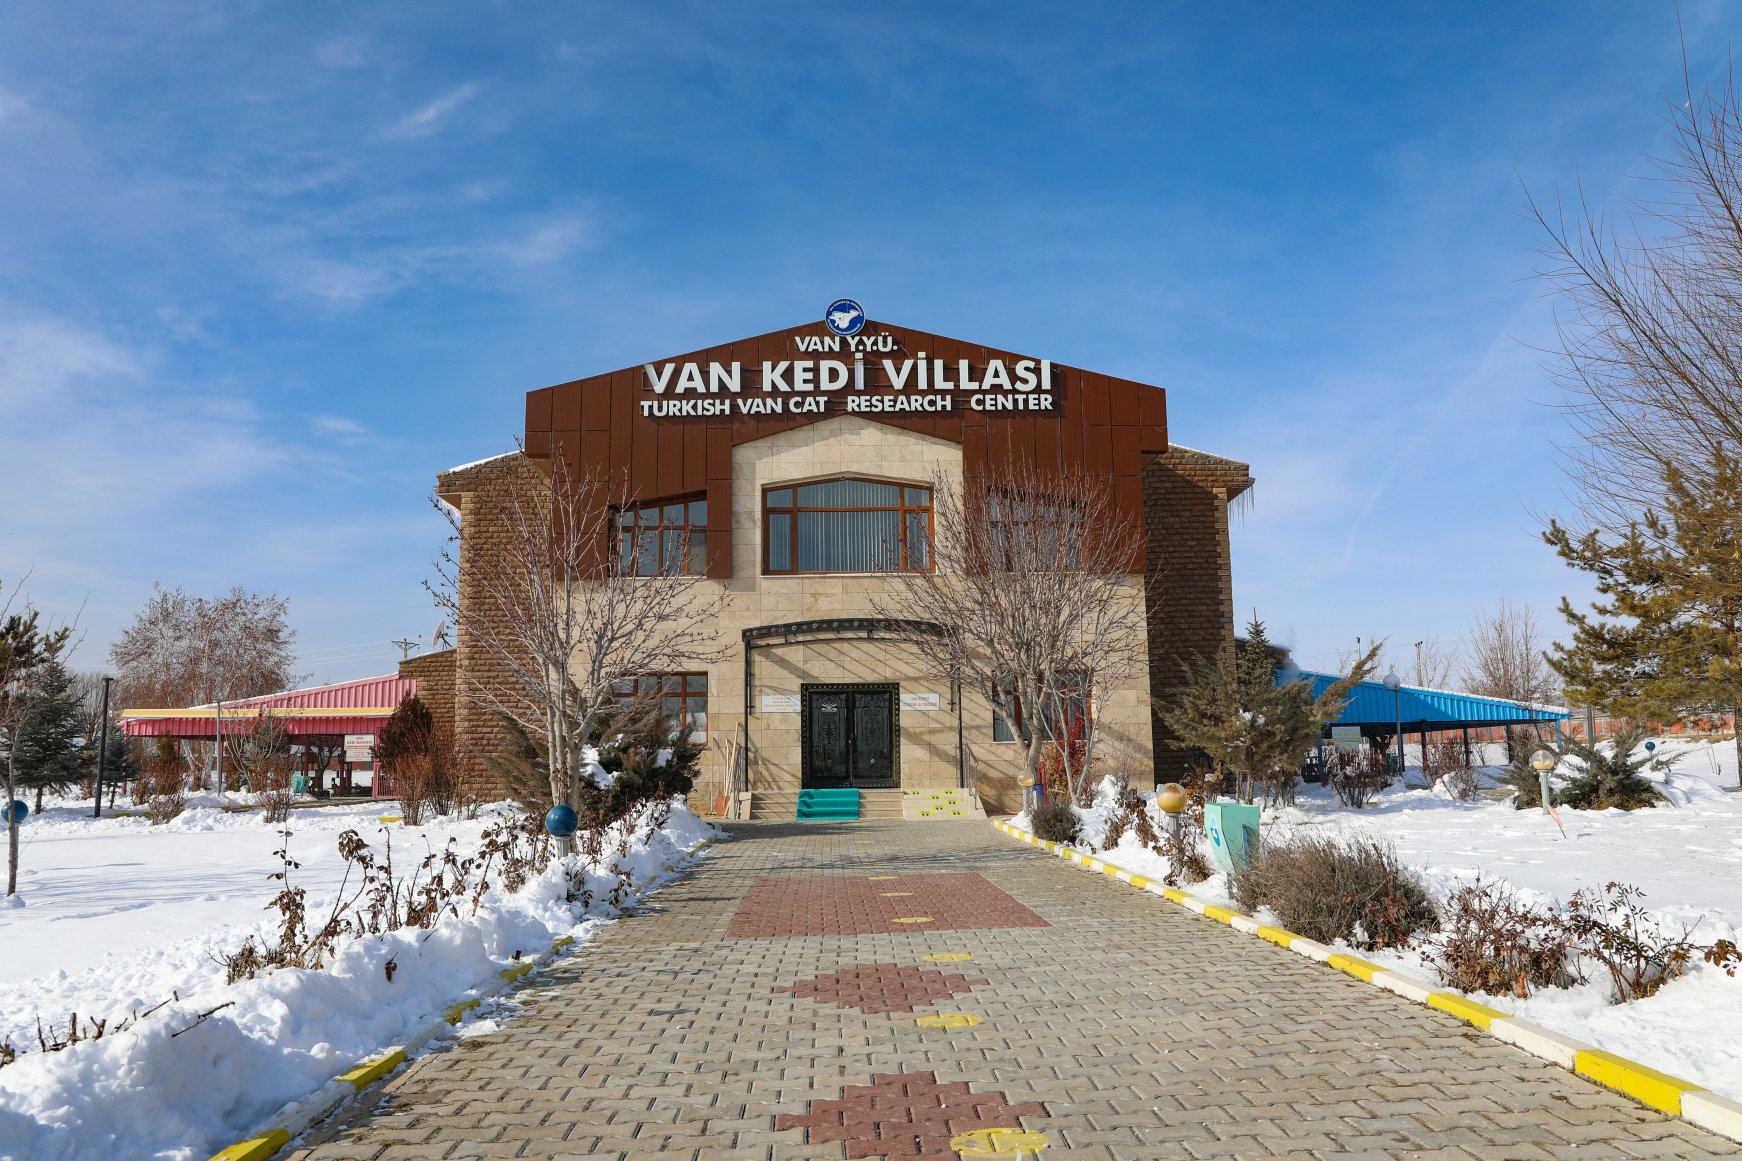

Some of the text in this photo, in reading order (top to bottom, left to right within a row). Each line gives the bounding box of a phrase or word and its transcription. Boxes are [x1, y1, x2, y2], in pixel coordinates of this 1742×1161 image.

[795, 332, 898, 352] VAN Y.Y.Ü.
[644, 351, 1051, 394] VAN KEDİ VİLLASI
[640, 394, 1054, 417] TURKISH VAN CAT RESEARCH CENTER
